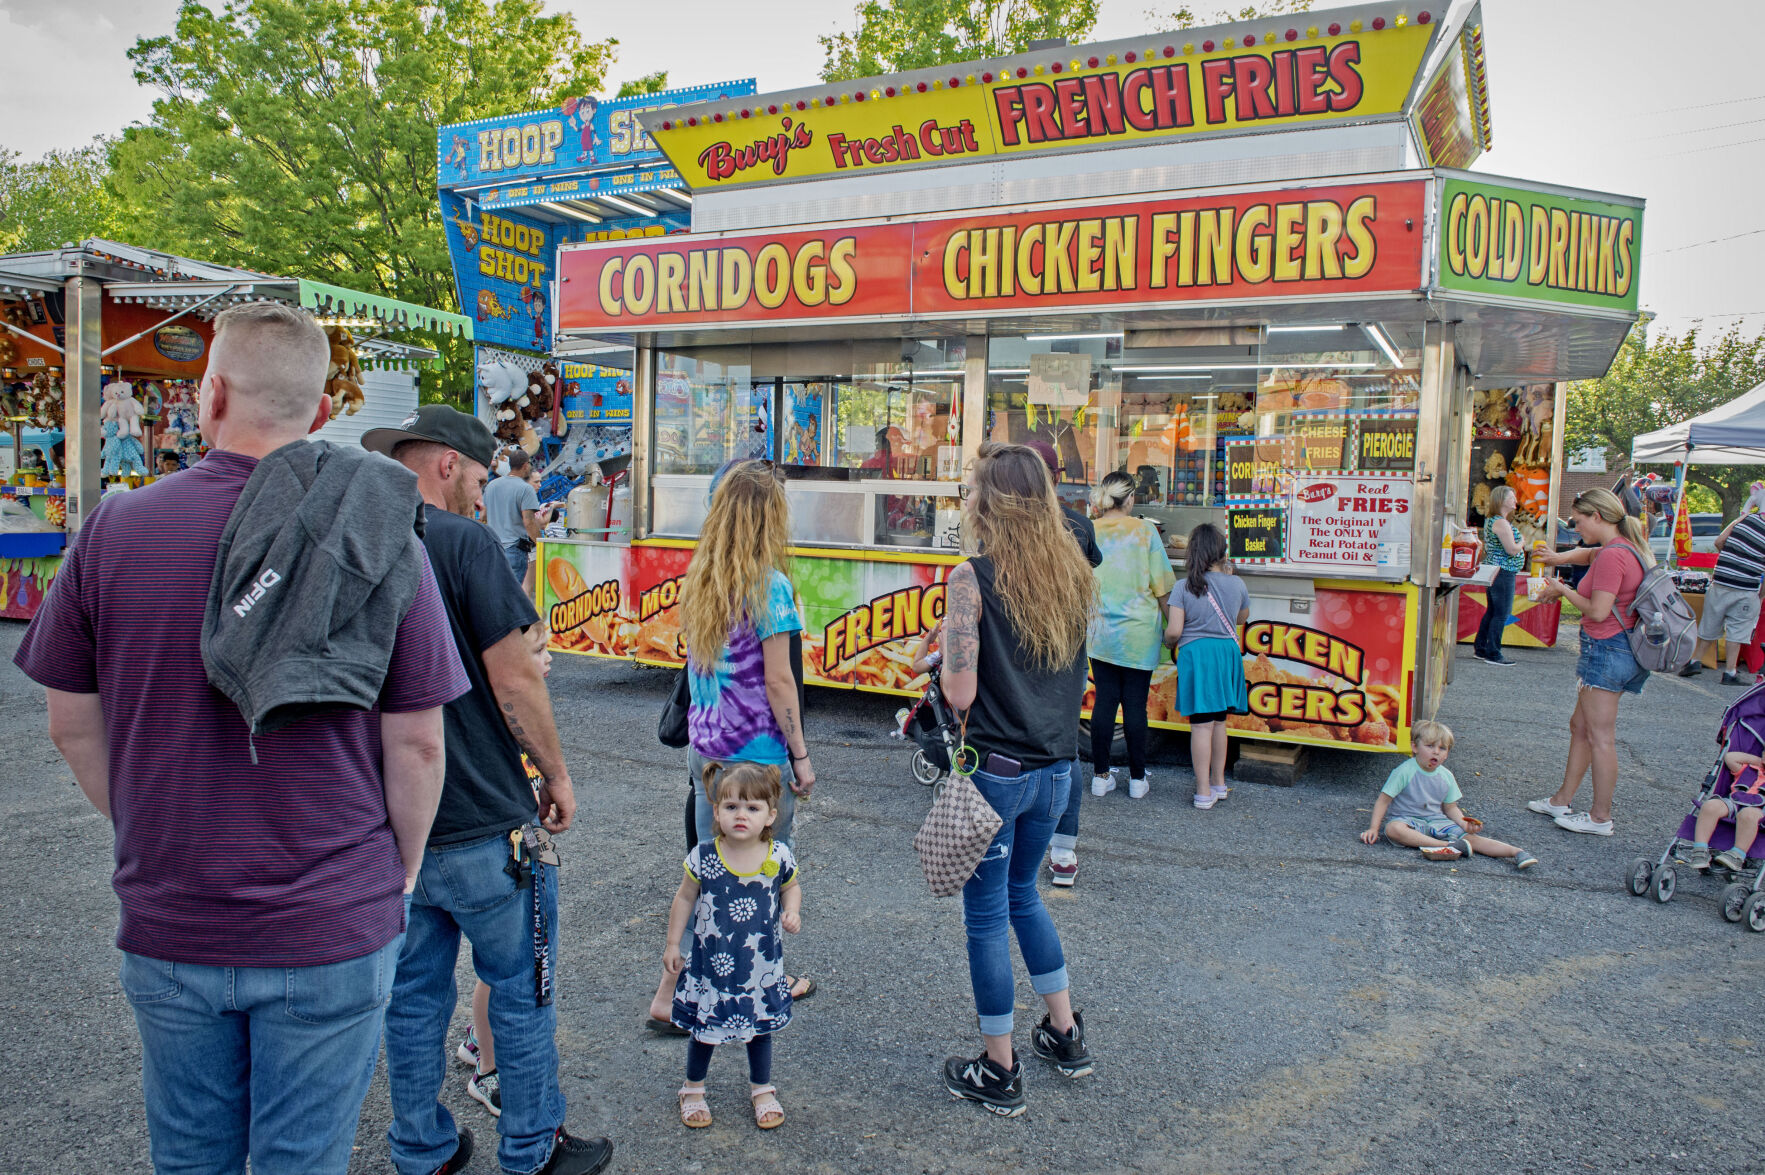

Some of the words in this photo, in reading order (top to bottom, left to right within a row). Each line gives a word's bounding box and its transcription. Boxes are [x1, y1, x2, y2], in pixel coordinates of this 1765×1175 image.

[993, 62, 1194, 146] FRENCH
[1201, 40, 1364, 125] FRIES
[478, 121, 563, 172] HOOP
[698, 117, 812, 181] Bury's
[826, 125, 921, 169] Fresh
[919, 119, 979, 157] Cut
[612, 174, 634, 185] ONE
[640, 172, 653, 182] IN
[508, 187, 528, 198] ONE
[533, 185, 545, 195] IN
[551, 181, 579, 193] WINS
[480, 212, 545, 257] HOOP
[943, 214, 1139, 300] CHICKEN
[1149, 196, 1378, 289] FINGERS
[1447, 192, 1524, 282] COLD
[1527, 204, 1634, 297] DRINKS
[479, 246, 545, 288] SHOT
[599, 236, 857, 317] CORNDOGS
[564, 364, 596, 379] HOOP
[567, 410, 584, 418] ONE
[590, 409, 600, 417] IN
[605, 409, 630, 417] WINS
[1300, 426, 1347, 438] CHEESE
[1307, 446, 1340, 458] FRIES
[1363, 432, 1414, 458] PIEROGIE
[1231, 462, 1257, 479] CORN
[1357, 483, 1390, 495] Real
[1338, 497, 1409, 513] FRIES
[1233, 514, 1257, 528] Chicken
[1258, 514, 1277, 531] Finger
[1301, 515, 1322, 525] The
[1325, 516, 1374, 528] Original
[1310, 527, 1331, 537] The
[1334, 528, 1364, 538] ONLY
[1245, 538, 1266, 551] Basket
[1309, 538, 1334, 549] Real
[1299, 549, 1338, 560] Peanut
[1342, 551, 1358, 561] Oil
[1362, 552, 1374, 561] &
[550, 579, 619, 634] CORNDOGS
[823, 582, 948, 672] FRENC
[1237, 619, 1365, 686] CKEN
[1248, 682, 1367, 728] GERS
